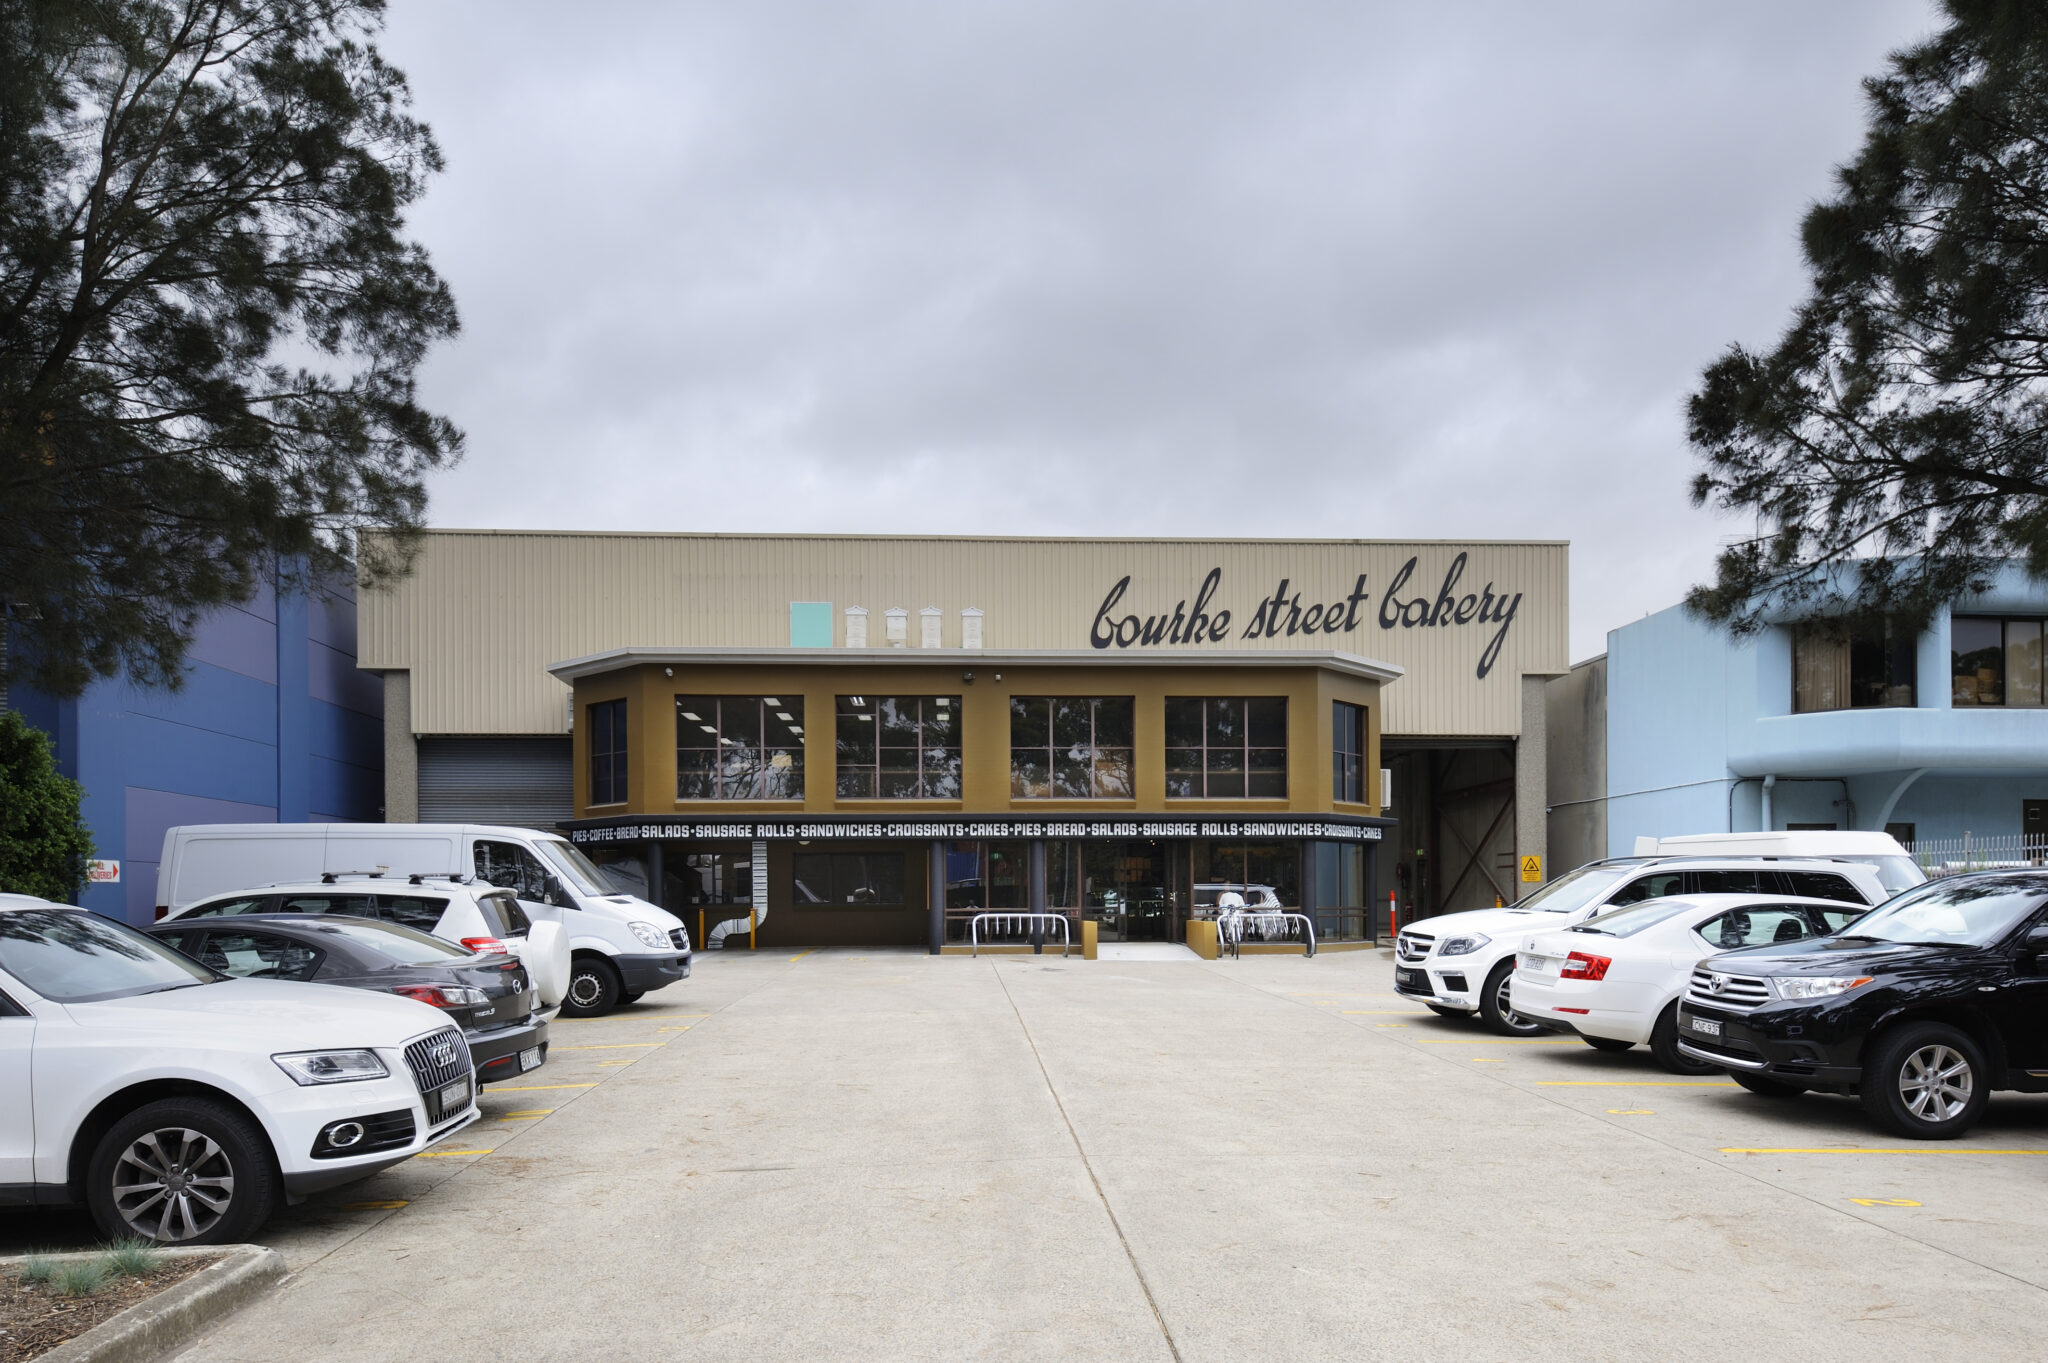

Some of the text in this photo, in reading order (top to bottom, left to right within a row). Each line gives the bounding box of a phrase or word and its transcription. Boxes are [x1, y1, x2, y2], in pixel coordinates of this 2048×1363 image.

[1090, 551, 1523, 680] bourke street bakery
[572, 823, 1382, 842] PIES COFFEE BREAD SALADS SAUSAGE ROLLS SANDWICHES CROISSANTS CAKES PIES BREAD SALADS SAUSAGE ROLLS SANDWICHES CROISSANTS CAKES
